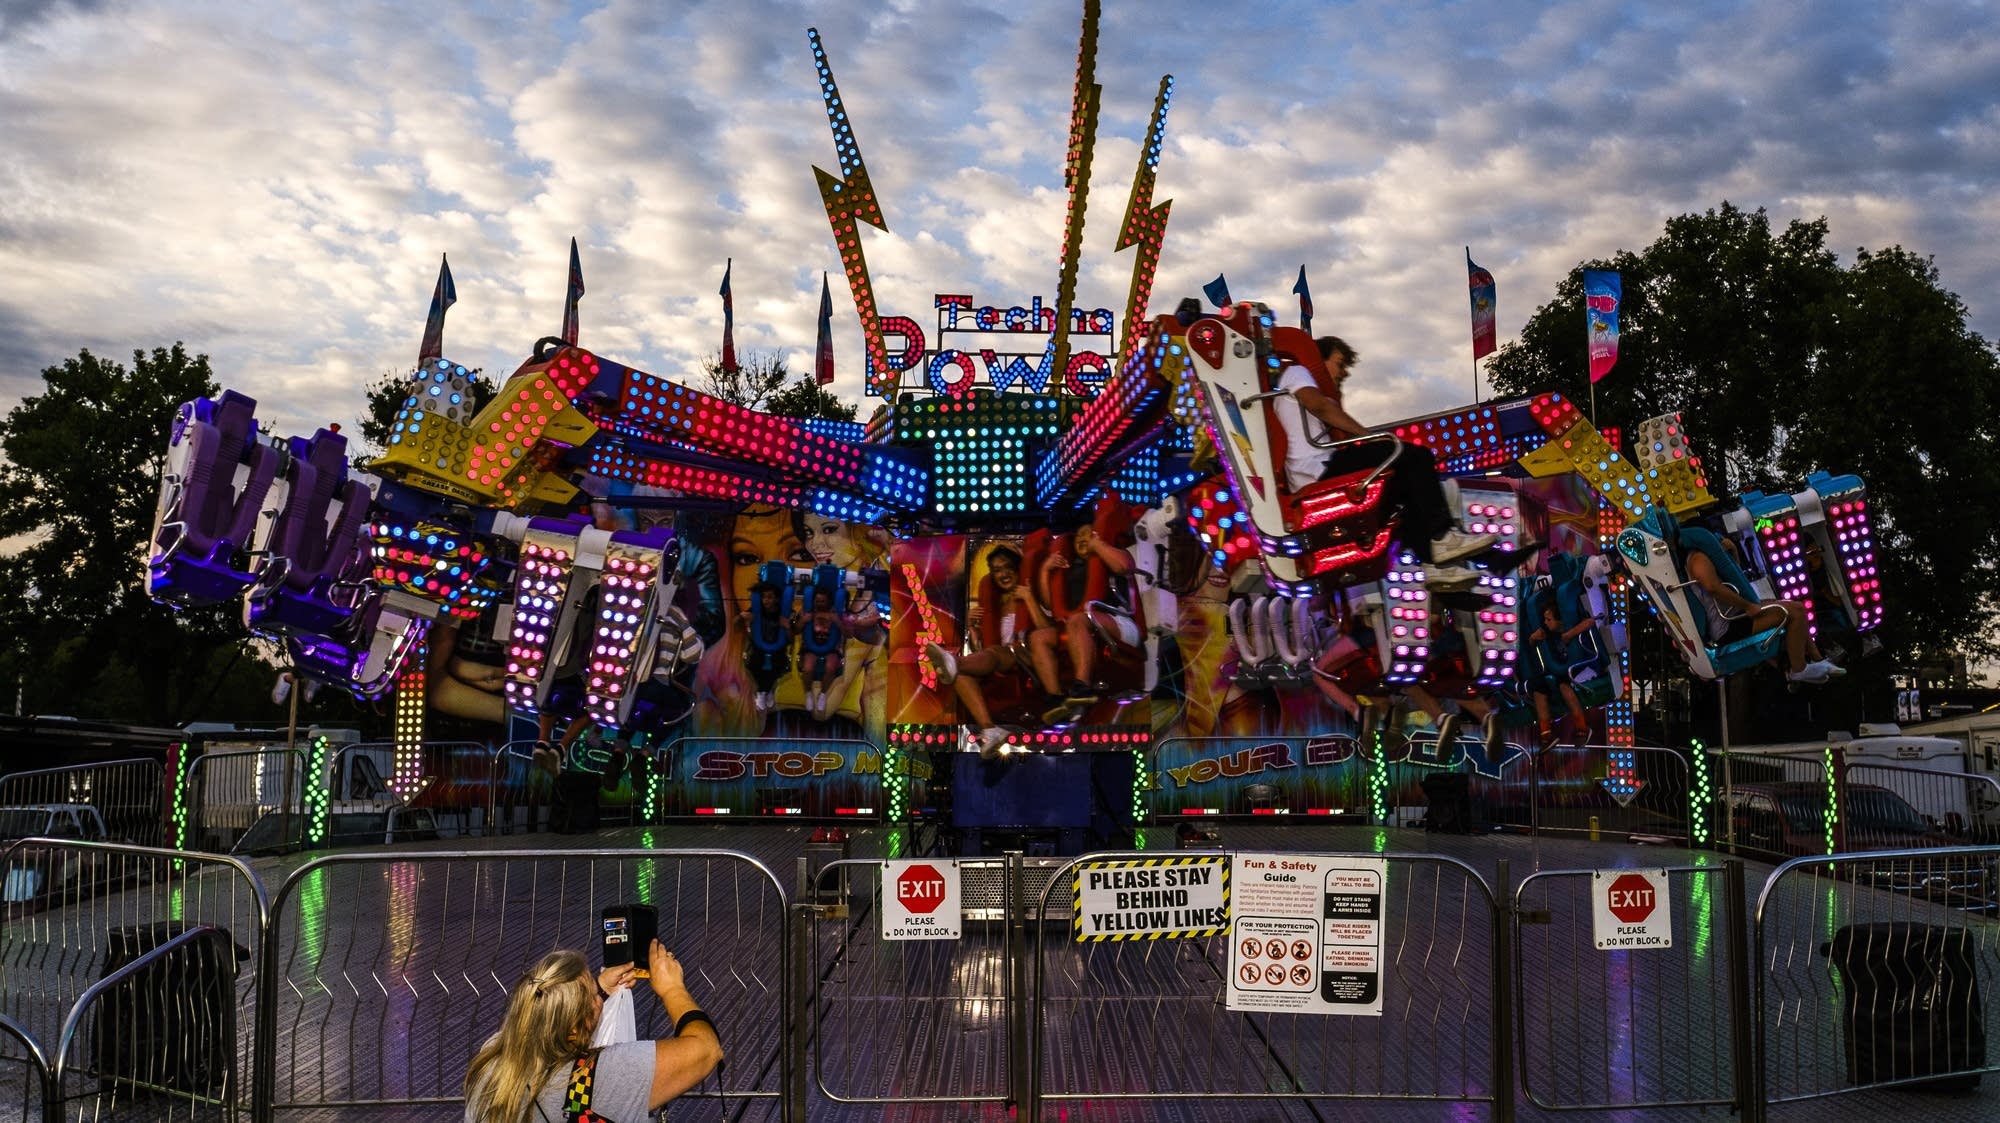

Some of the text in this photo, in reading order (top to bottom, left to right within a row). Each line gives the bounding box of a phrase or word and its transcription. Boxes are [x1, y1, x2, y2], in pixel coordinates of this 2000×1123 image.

[692, 750, 844, 780] STOP
[1167, 743, 1297, 788] YOUR
[1244, 859, 1317, 872] Fun & Safety
[1090, 867, 1211, 890] PLEASE STAY
[1263, 872, 1297, 882] Guide
[899, 880, 943, 898] EXIT
[1116, 889, 1189, 909] BEHIND
[1610, 889, 1653, 908] EXIT
[905, 917, 935, 925] PLEASE
[1091, 907, 1227, 931] YELLOW LINES
[893, 928, 949, 936] DO NOT BLOCK
[1617, 926, 1647, 935] PLEASE
[1606, 938, 1617, 946] DO
[1636, 937, 1661, 945] BLOCK
